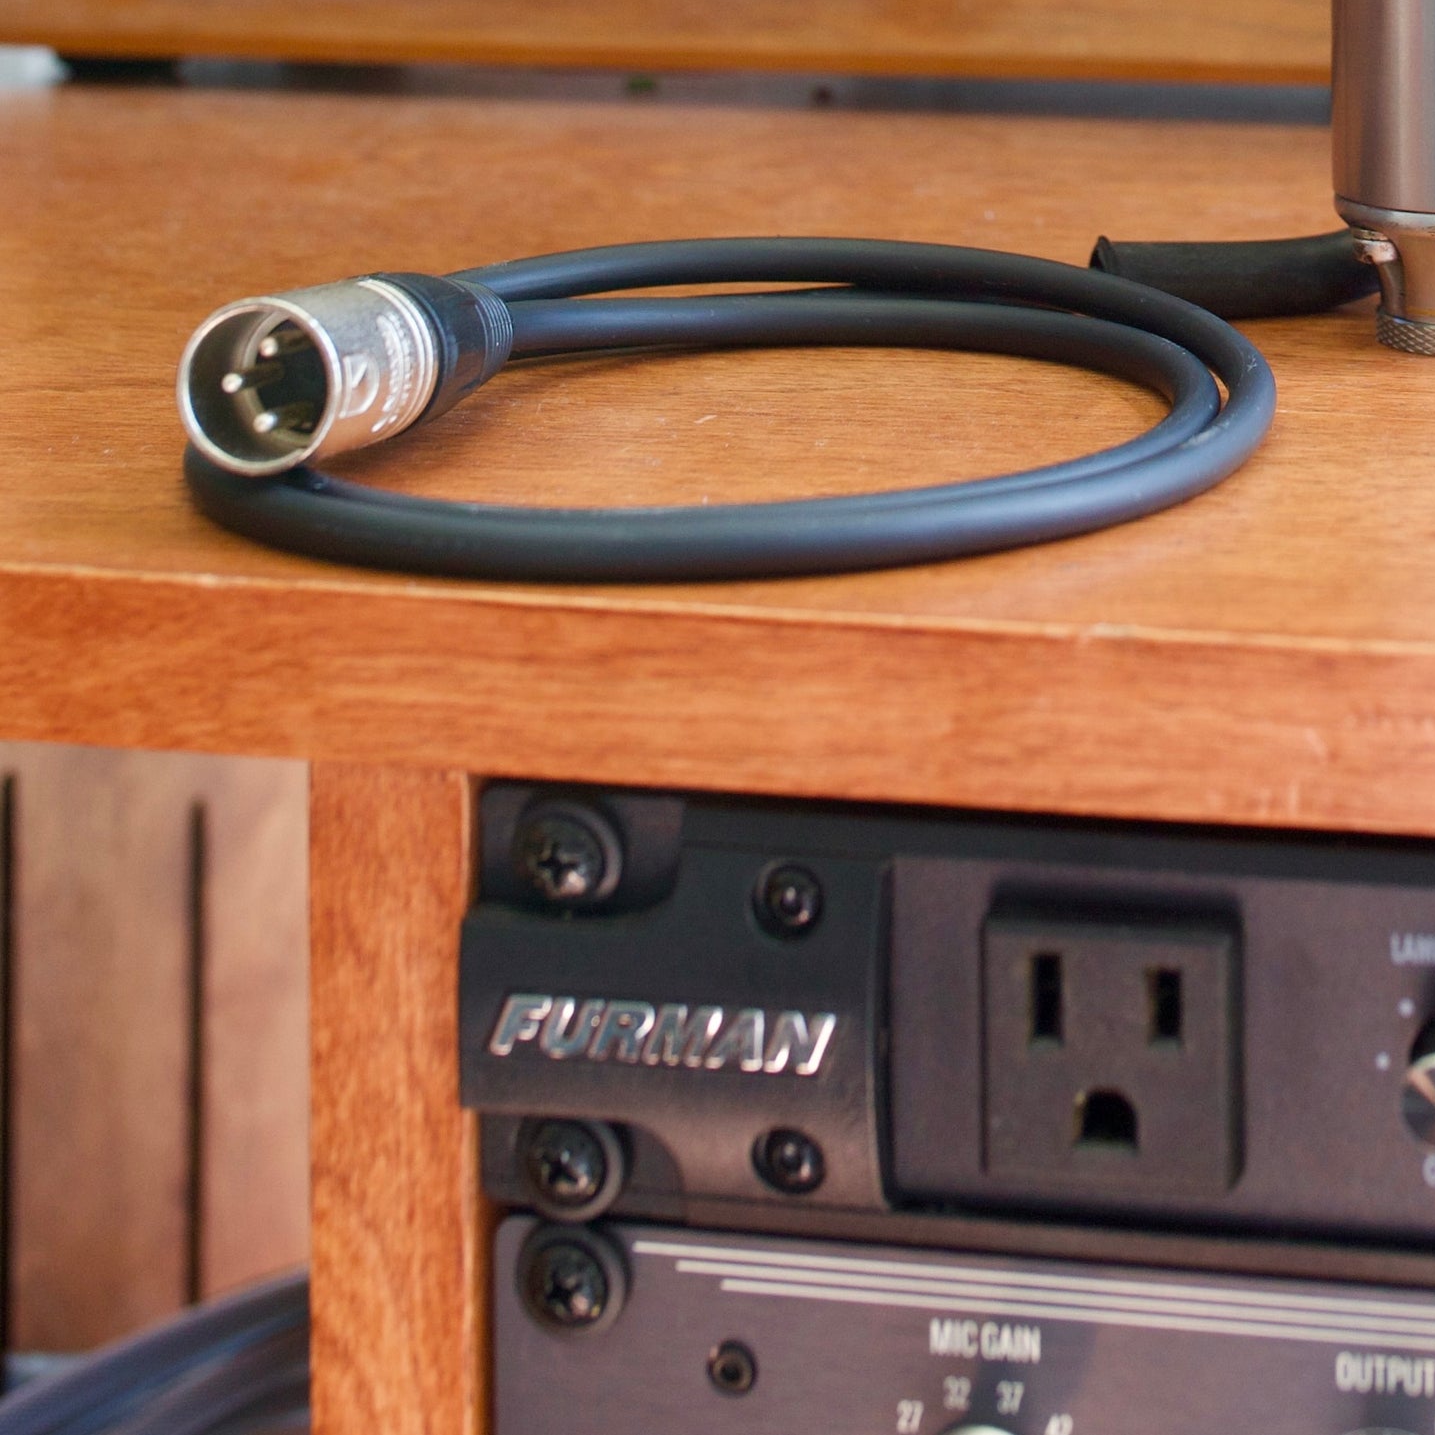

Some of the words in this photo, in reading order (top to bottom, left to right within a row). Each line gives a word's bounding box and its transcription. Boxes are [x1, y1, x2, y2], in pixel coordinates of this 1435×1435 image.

[490, 994, 837, 1076] FURMAN
[929, 1317, 979, 1358] MIC
[980, 1321, 1042, 1363] GAIN
